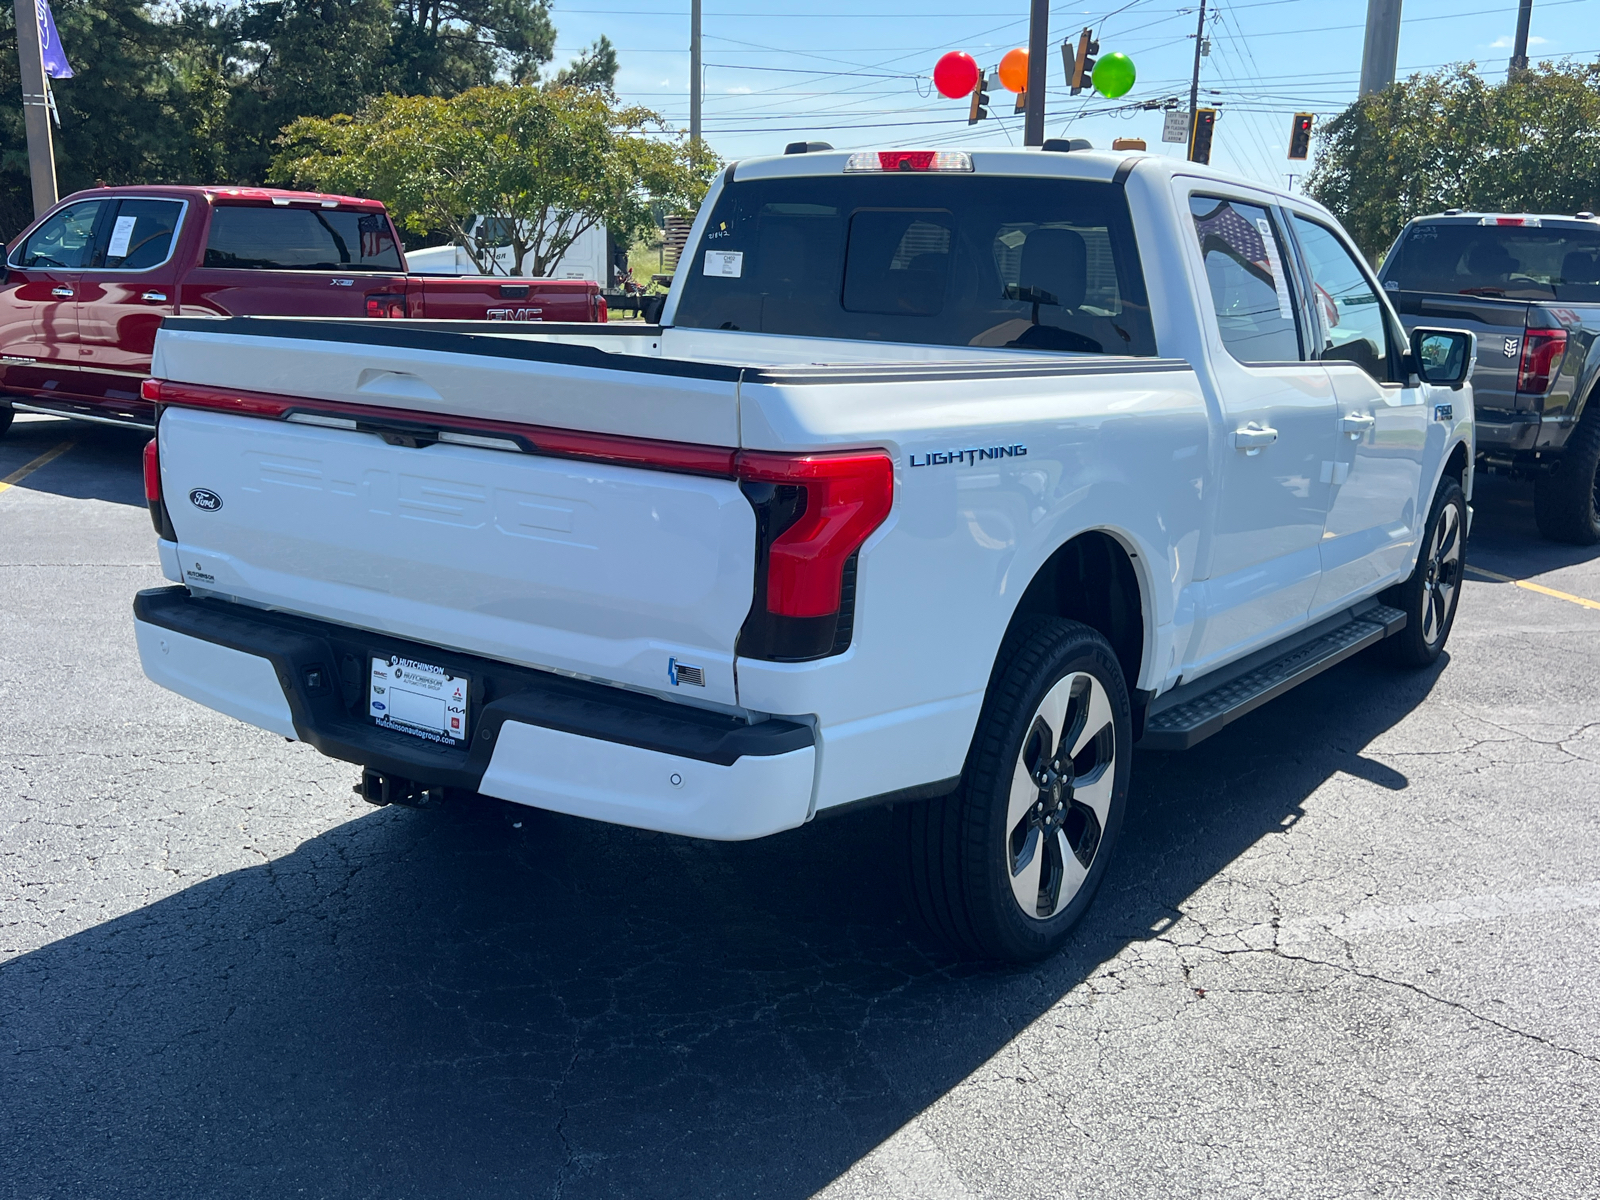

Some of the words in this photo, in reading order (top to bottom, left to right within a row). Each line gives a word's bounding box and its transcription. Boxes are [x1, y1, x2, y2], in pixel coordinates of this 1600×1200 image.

[910, 443, 1027, 468] LIGHTNING
[194, 492, 216, 508] Ford
[399, 658, 445, 674] HUTCHINSON
[403, 672, 443, 686] HUTCHINSON
[403, 679, 427, 688] AUTOMOTIVE
[375, 718, 456, 746] Hutchinsonautogroup.com
